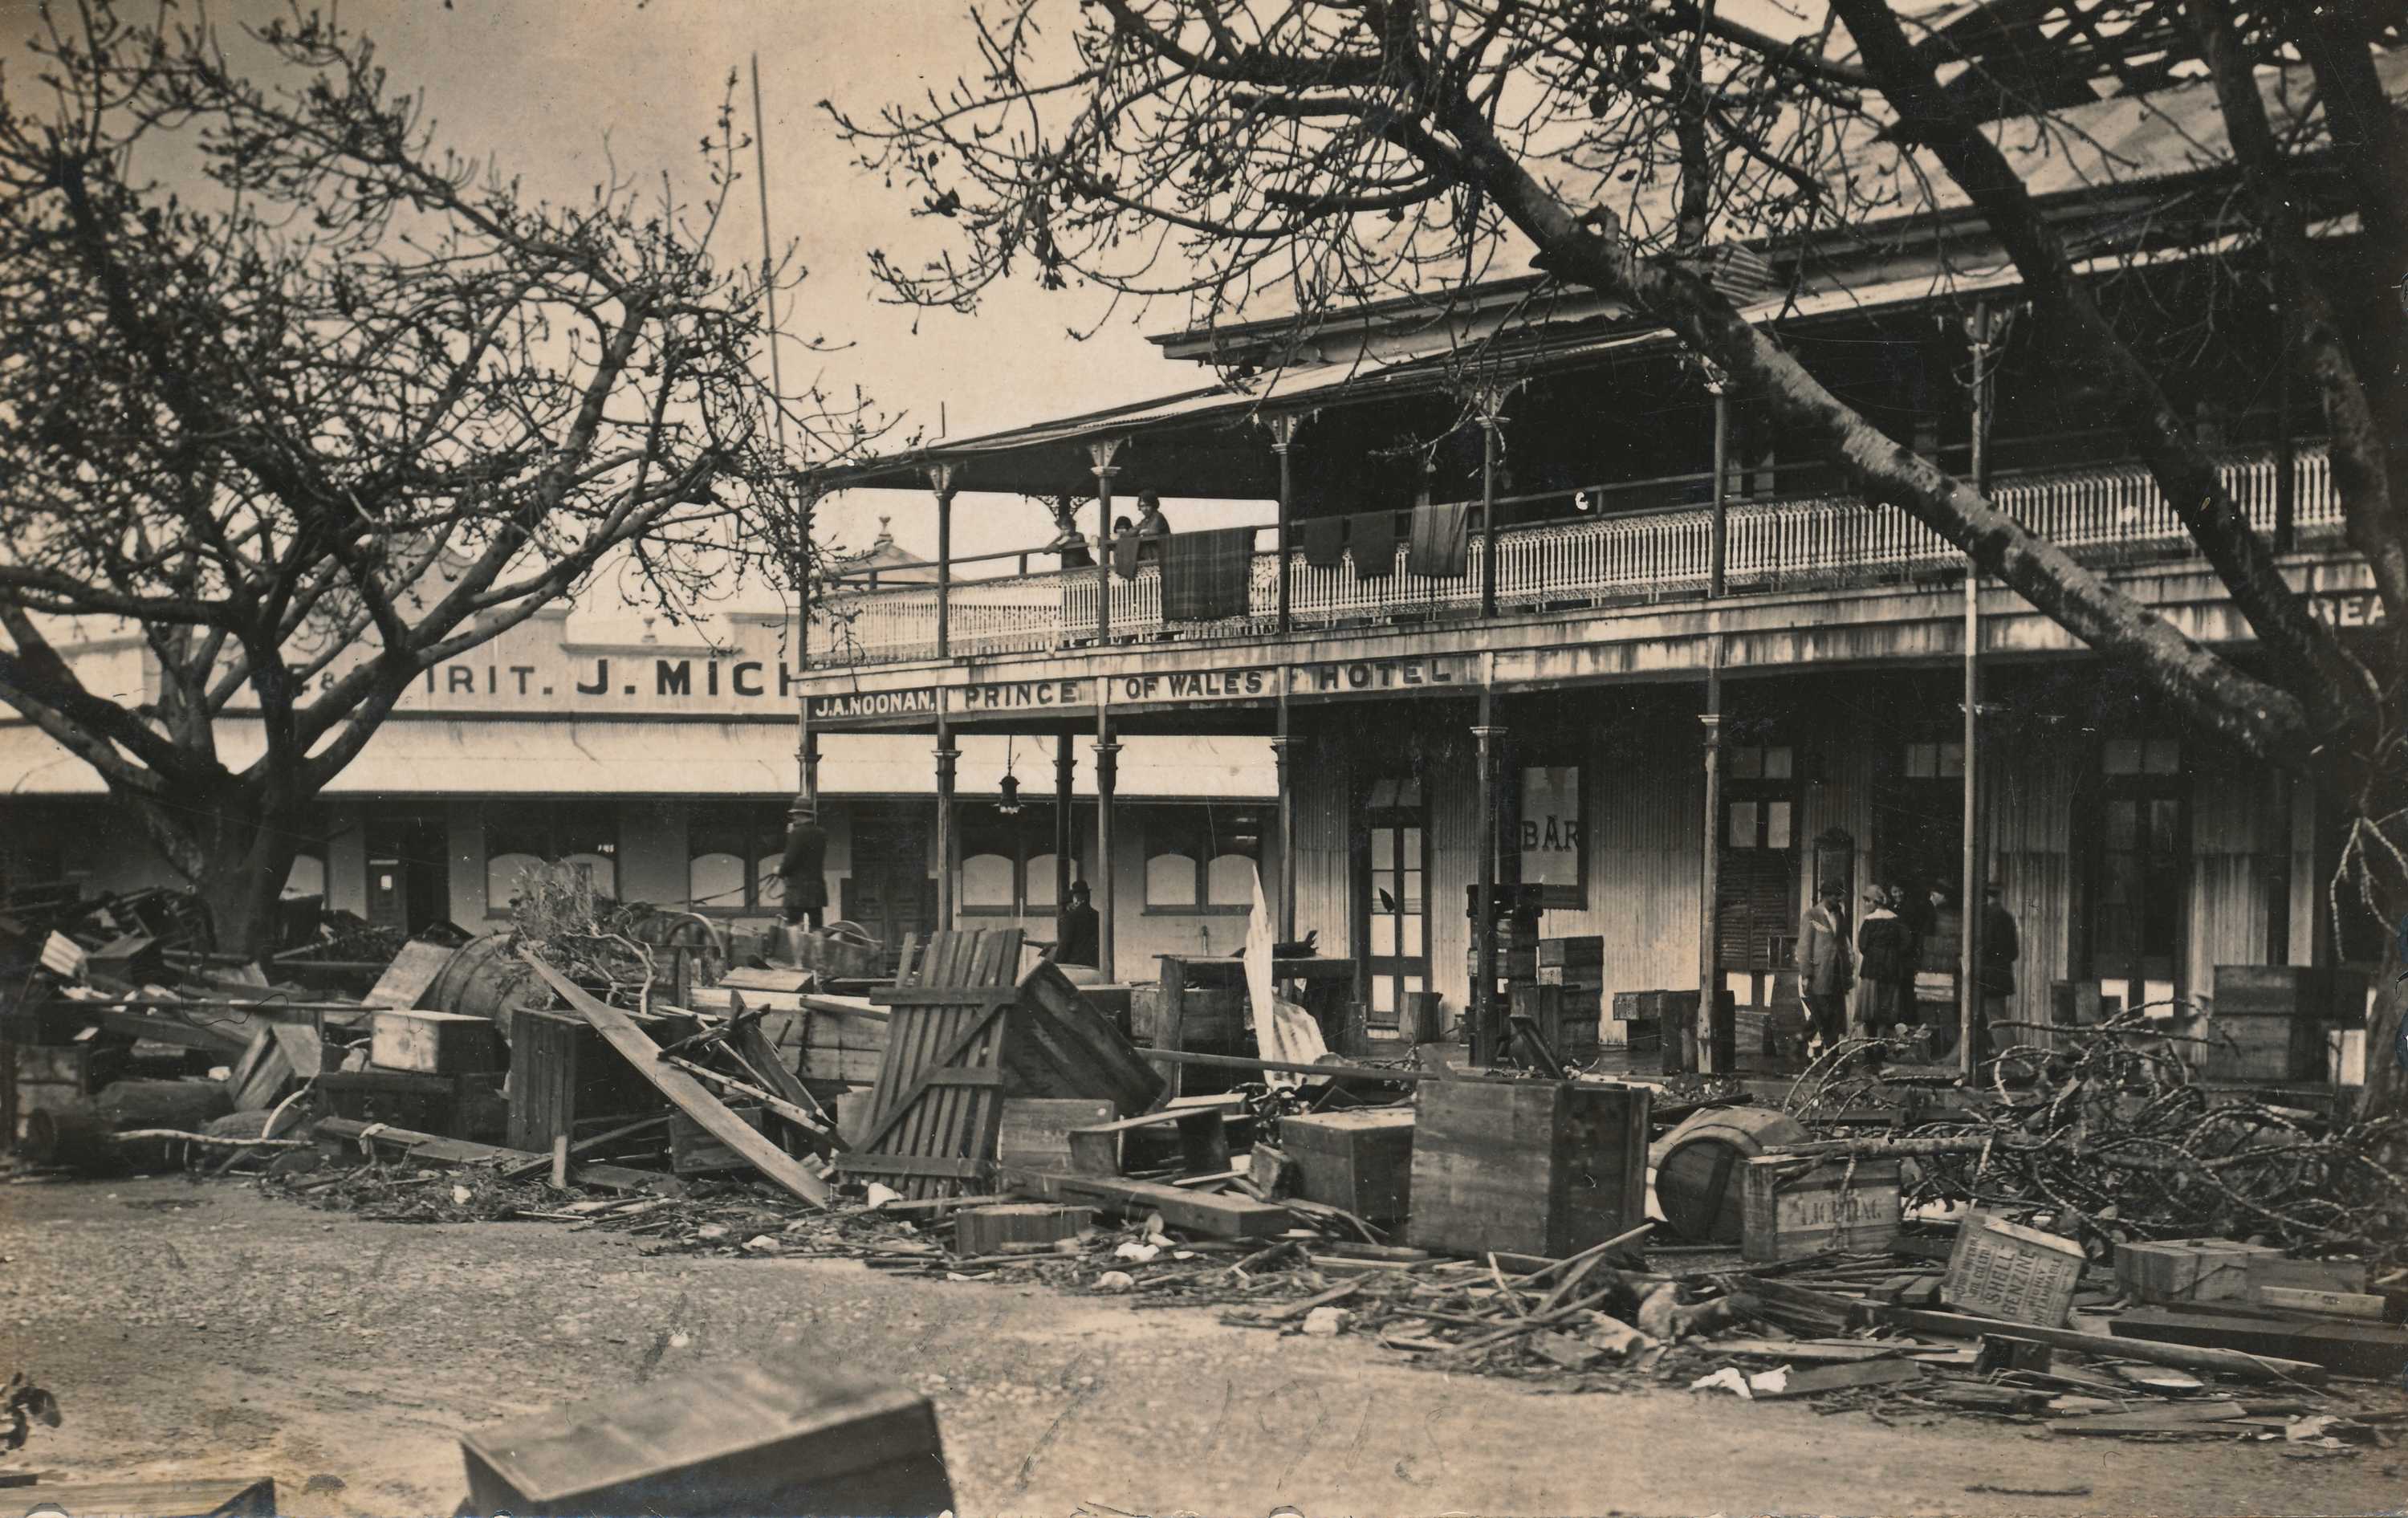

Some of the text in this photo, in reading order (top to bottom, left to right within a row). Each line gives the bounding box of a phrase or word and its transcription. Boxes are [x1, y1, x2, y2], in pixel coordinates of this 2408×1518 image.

[426, 665, 554, 696] IRIT.
[576, 659, 636, 696] J.
[965, 683, 1077, 709] PRINCE
[1125, 677, 1159, 699] OF
[1168, 672, 1263, 698] WALES
[1320, 659, 1451, 690] HOTEL
[1522, 815, 1580, 852] BAR
[2003, 1249, 2037, 1317] BENZINE
